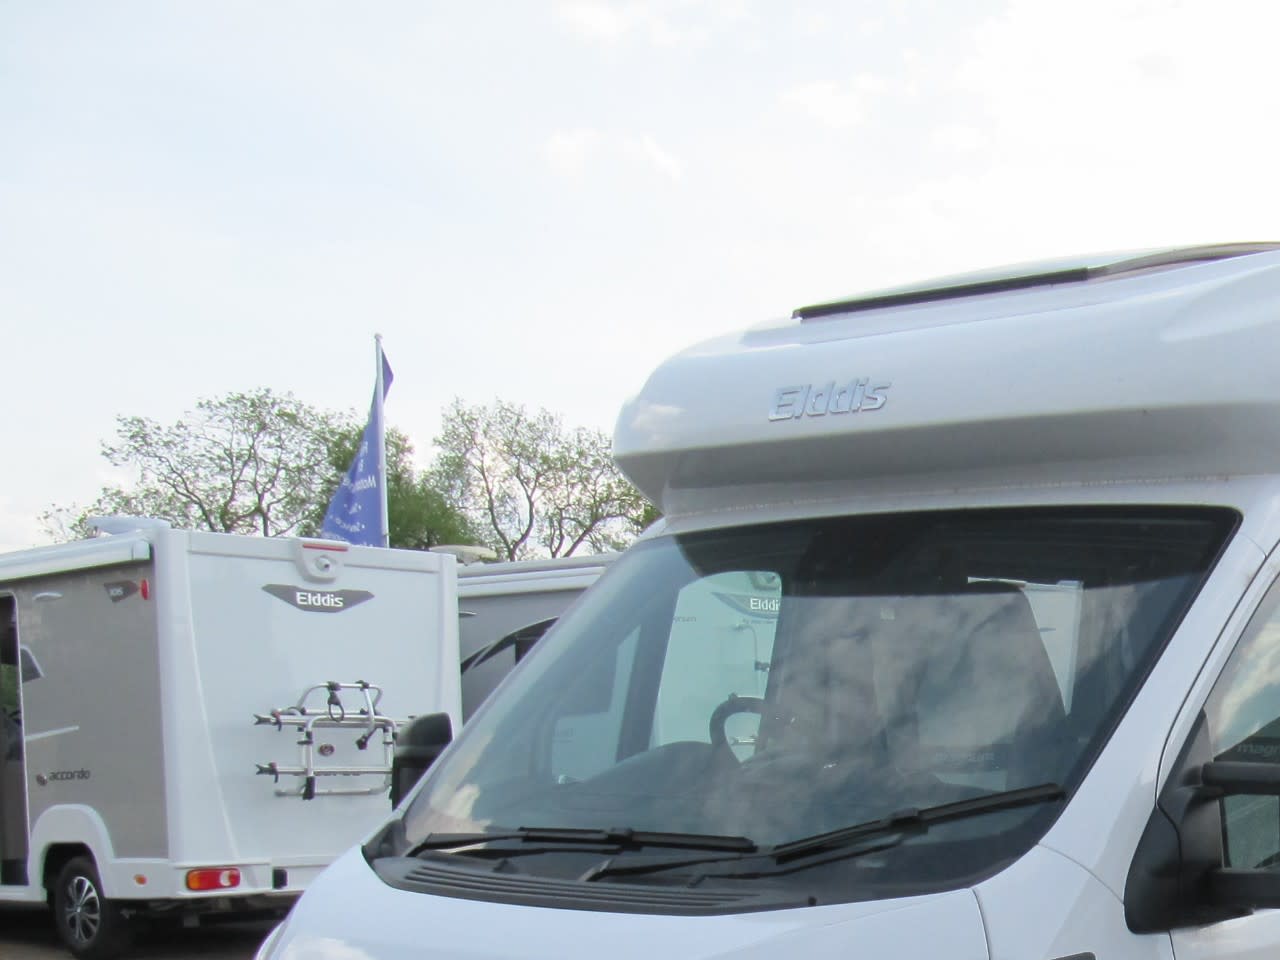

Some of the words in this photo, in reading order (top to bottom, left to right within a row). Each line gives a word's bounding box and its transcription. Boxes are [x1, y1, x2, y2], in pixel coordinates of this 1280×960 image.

[768, 377, 891, 422] Elddis
[295, 591, 344, 608] Elddis
[48, 767, 91, 781] accordo
